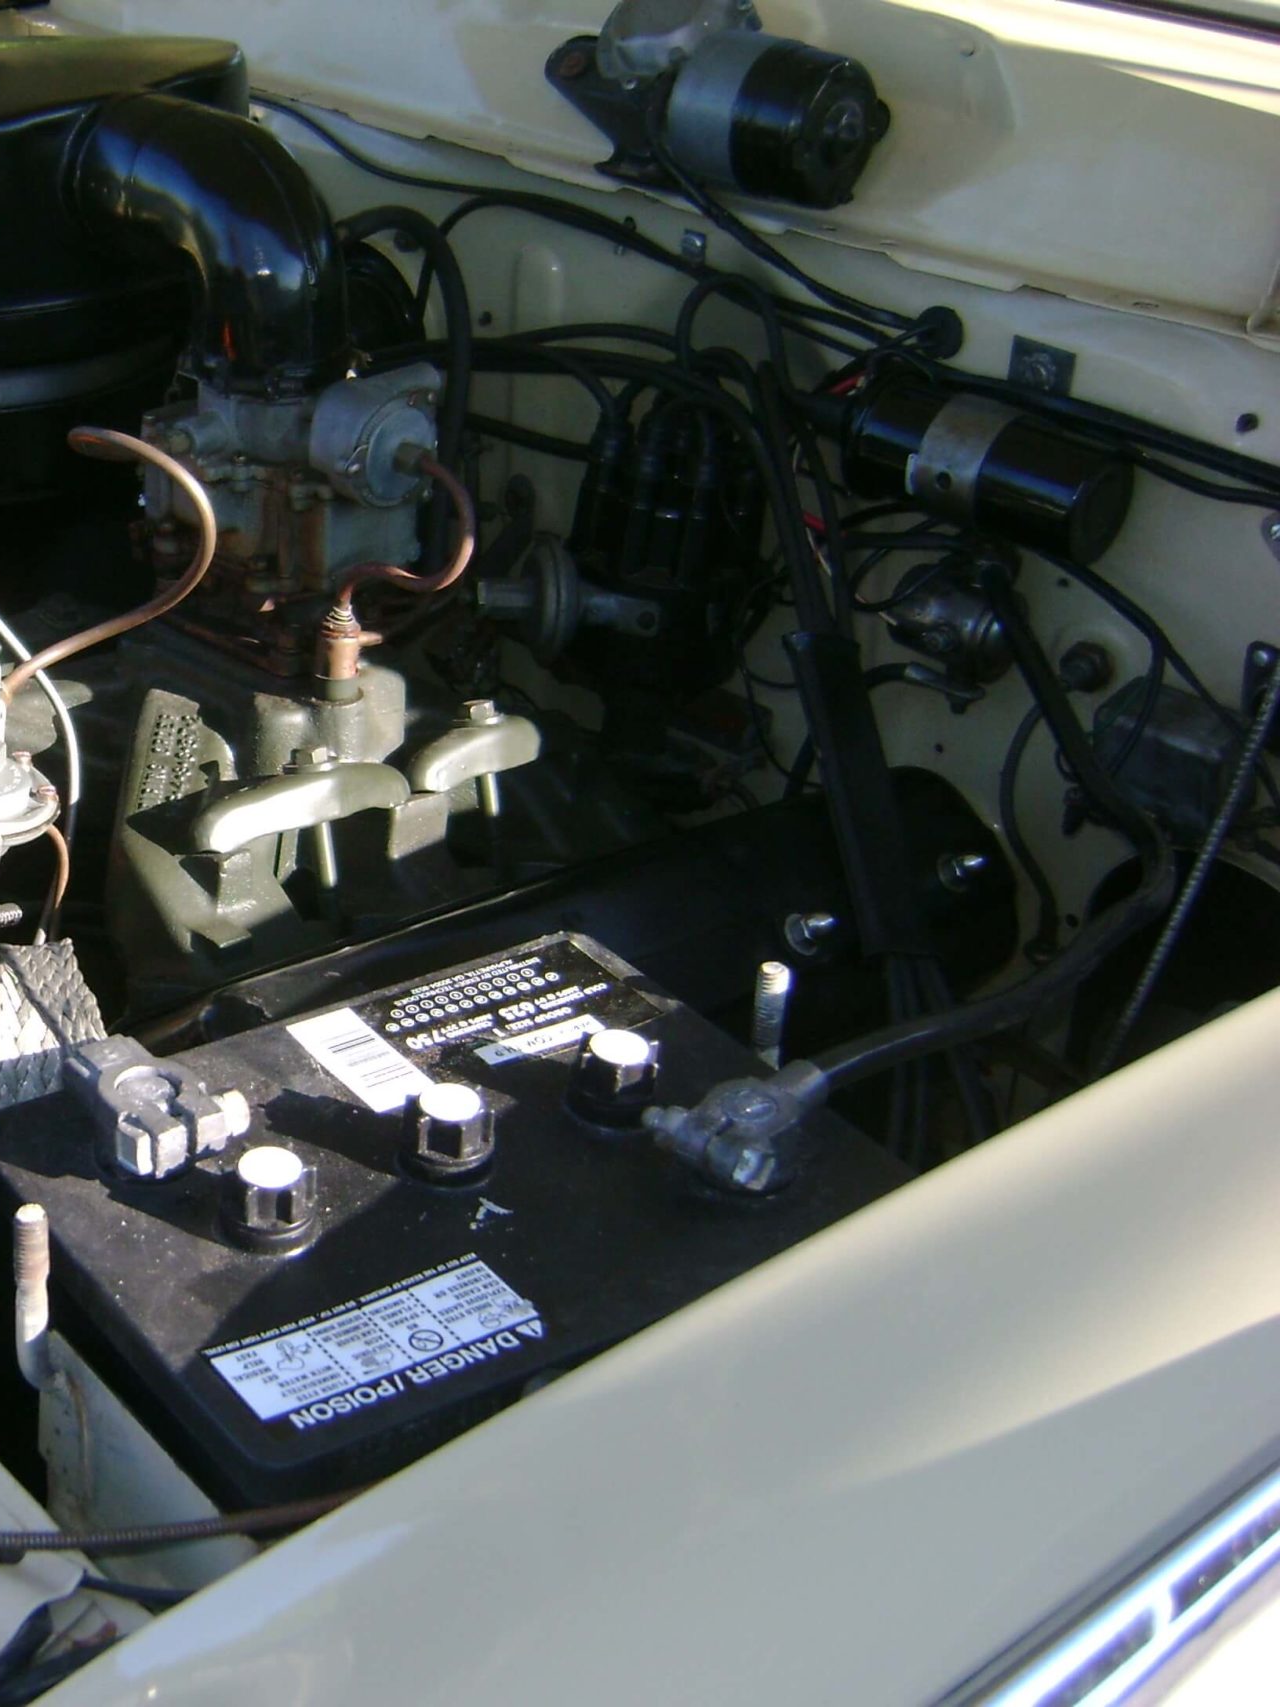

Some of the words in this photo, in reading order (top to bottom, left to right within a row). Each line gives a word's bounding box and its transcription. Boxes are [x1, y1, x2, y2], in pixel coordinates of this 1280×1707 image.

[491, 957, 539, 975] DISTRIBUTED
[394, 985, 453, 1005] TECHNOLOGIES
[583, 983, 606, 994] COLD
[498, 1001, 534, 1019] 625
[534, 1007, 571, 1022] GROUP
[406, 1030, 445, 1049] 750
[448, 1273, 491, 1292] BLINDNESS
[454, 1287, 480, 1299] CAUSE
[465, 1287, 506, 1304] EXPLOSIVE
[444, 1312, 464, 1323] EYES
[406, 1332, 518, 1382] DANGER
[278, 1374, 307, 1387] WATER
